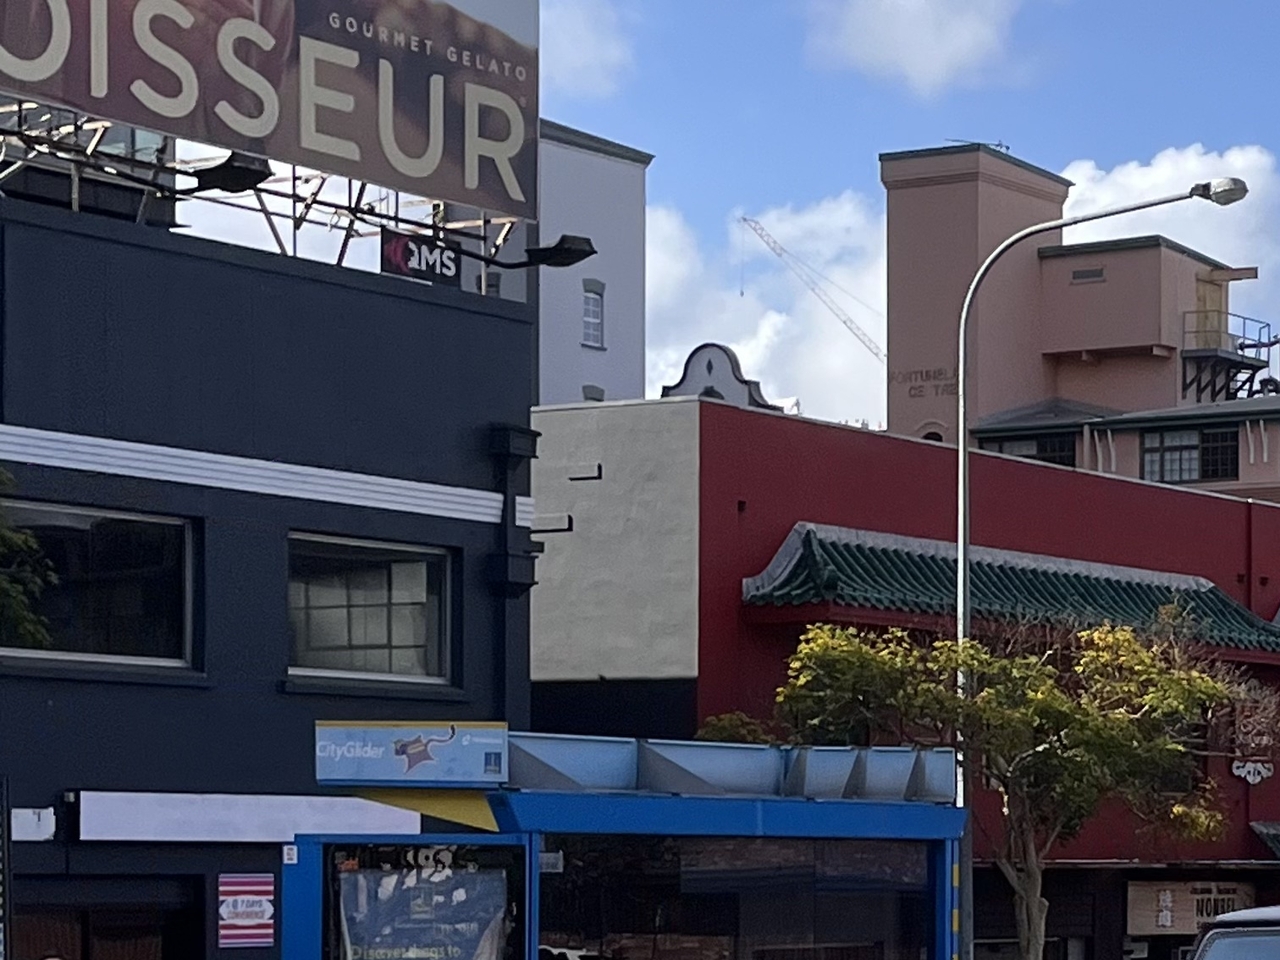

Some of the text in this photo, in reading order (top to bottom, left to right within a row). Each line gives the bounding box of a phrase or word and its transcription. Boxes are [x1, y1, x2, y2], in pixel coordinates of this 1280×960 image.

[329, 12, 527, 81] GOURMET GELATO
[0, 0, 526, 203] OISSEUR
[316, 740, 386, 762] CityGlider
